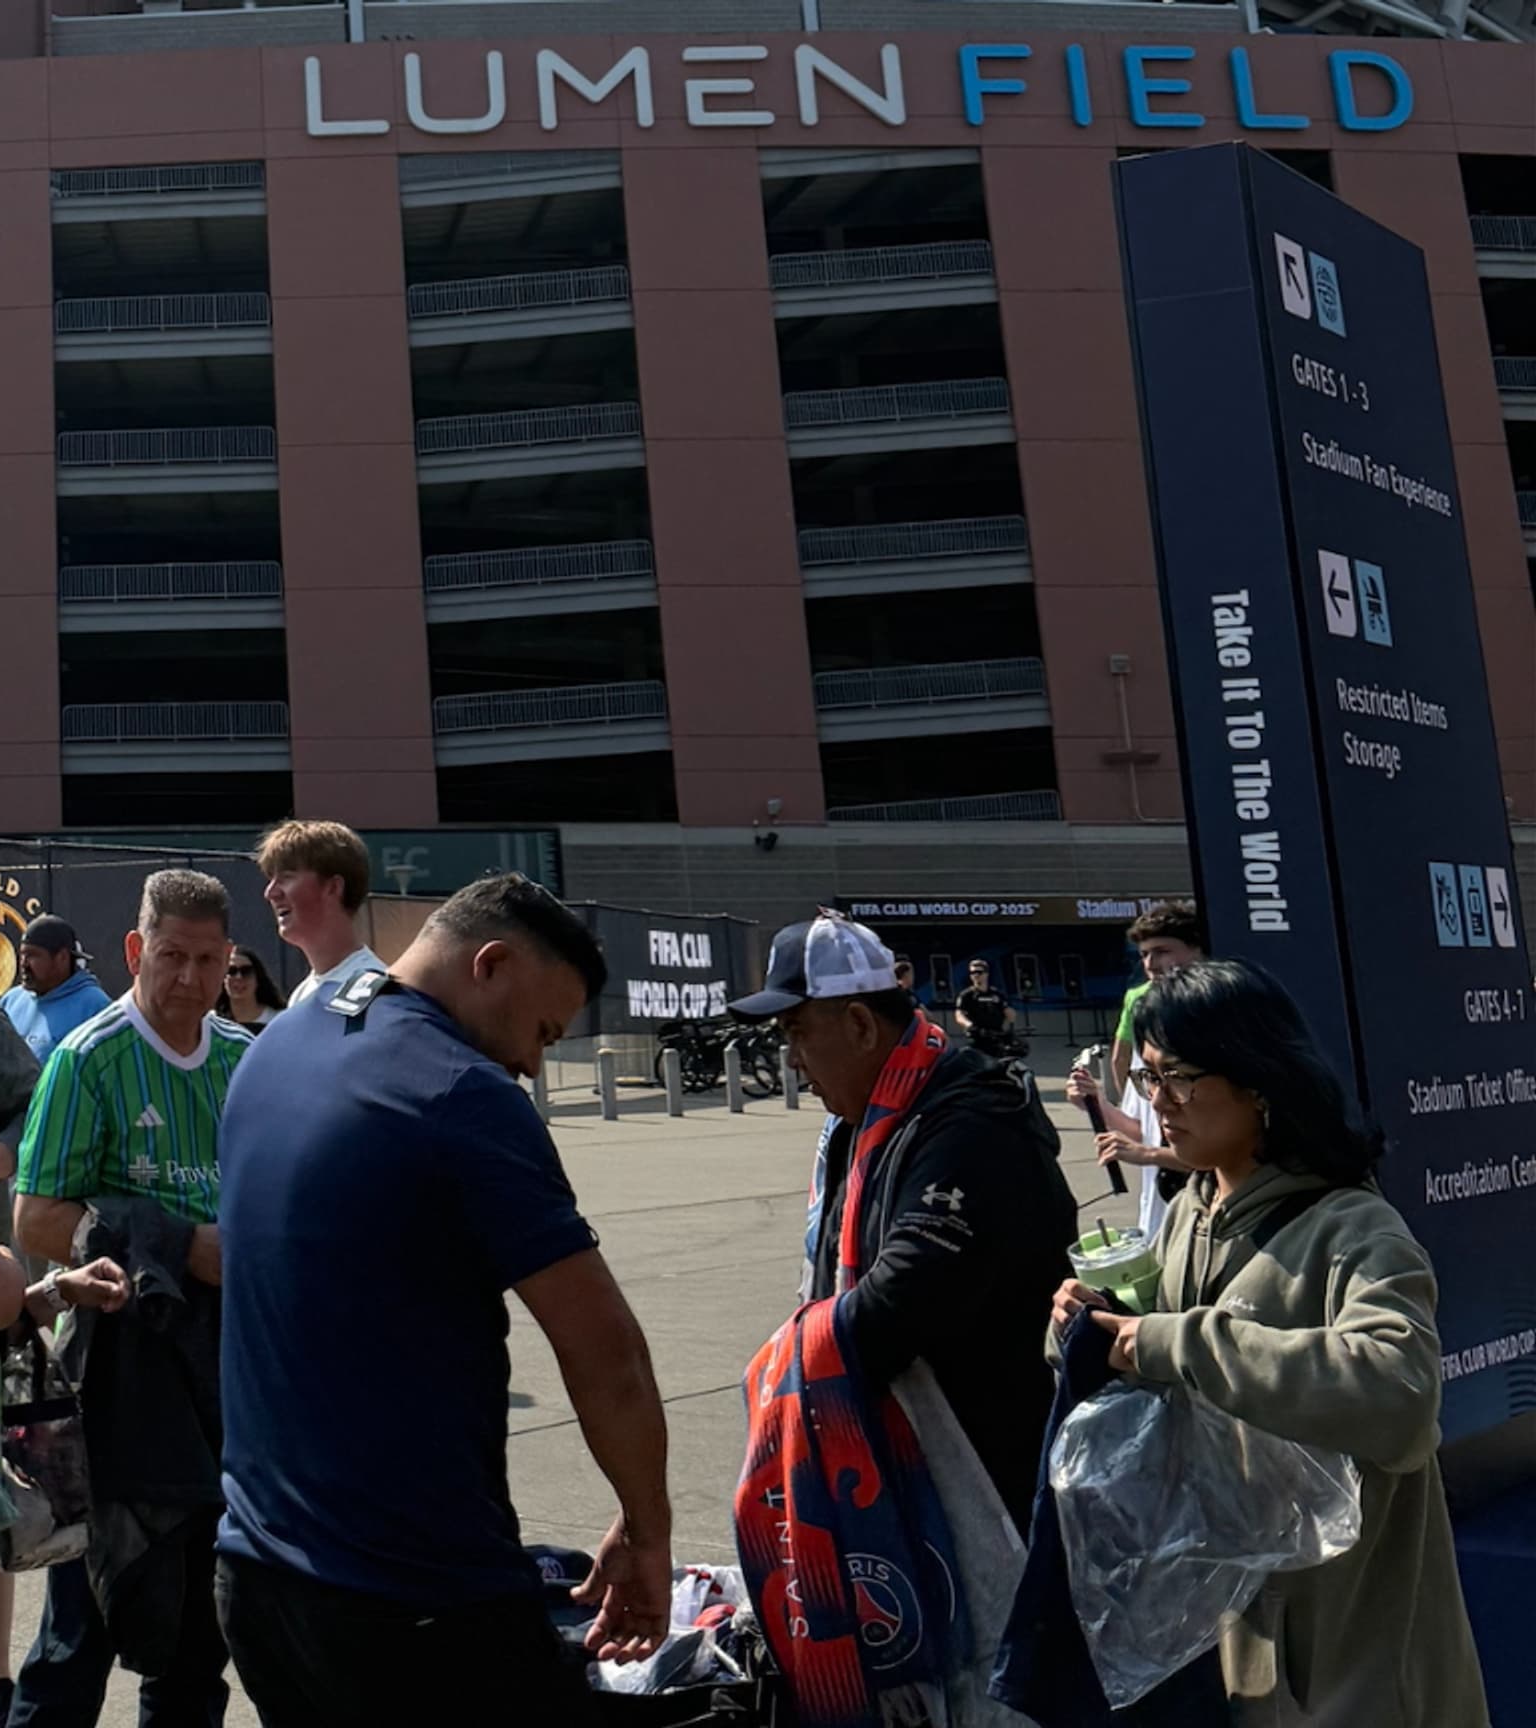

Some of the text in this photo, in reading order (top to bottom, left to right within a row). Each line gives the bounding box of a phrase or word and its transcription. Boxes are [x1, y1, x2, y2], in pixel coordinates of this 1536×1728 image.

[304, 43, 1414, 136] LUMEN FIELD
[1292, 353, 1337, 397] GATES
[1340, 373, 1349, 403] 1
[1358, 381, 1370, 412] 3
[1302, 431, 1452, 517] Stadium Fan Experience
[1336, 677, 1448, 729] Restricted Items
[1212, 589, 1290, 932] Take It To The World
[1344, 731, 1401, 779] Storage
[851, 904, 881, 916] FIFA
[882, 904, 918, 916] CLUB
[919, 903, 969, 916] WORLD
[970, 904, 999, 916] CUP
[1077, 898, 1137, 918] Stadium
[648, 930, 682, 967] FIFA
[627, 980, 680, 1018] WORLD
[680, 983, 709, 1018] CUP
[1464, 989, 1501, 1022] GATES
[1503, 989, 1511, 1022] 4
[1407, 1076, 1465, 1115] Stadium
[1465, 1072, 1505, 1108] Ticket
[1425, 1158, 1511, 1204] Accreditation
[848, 1559, 890, 1581] RIS
